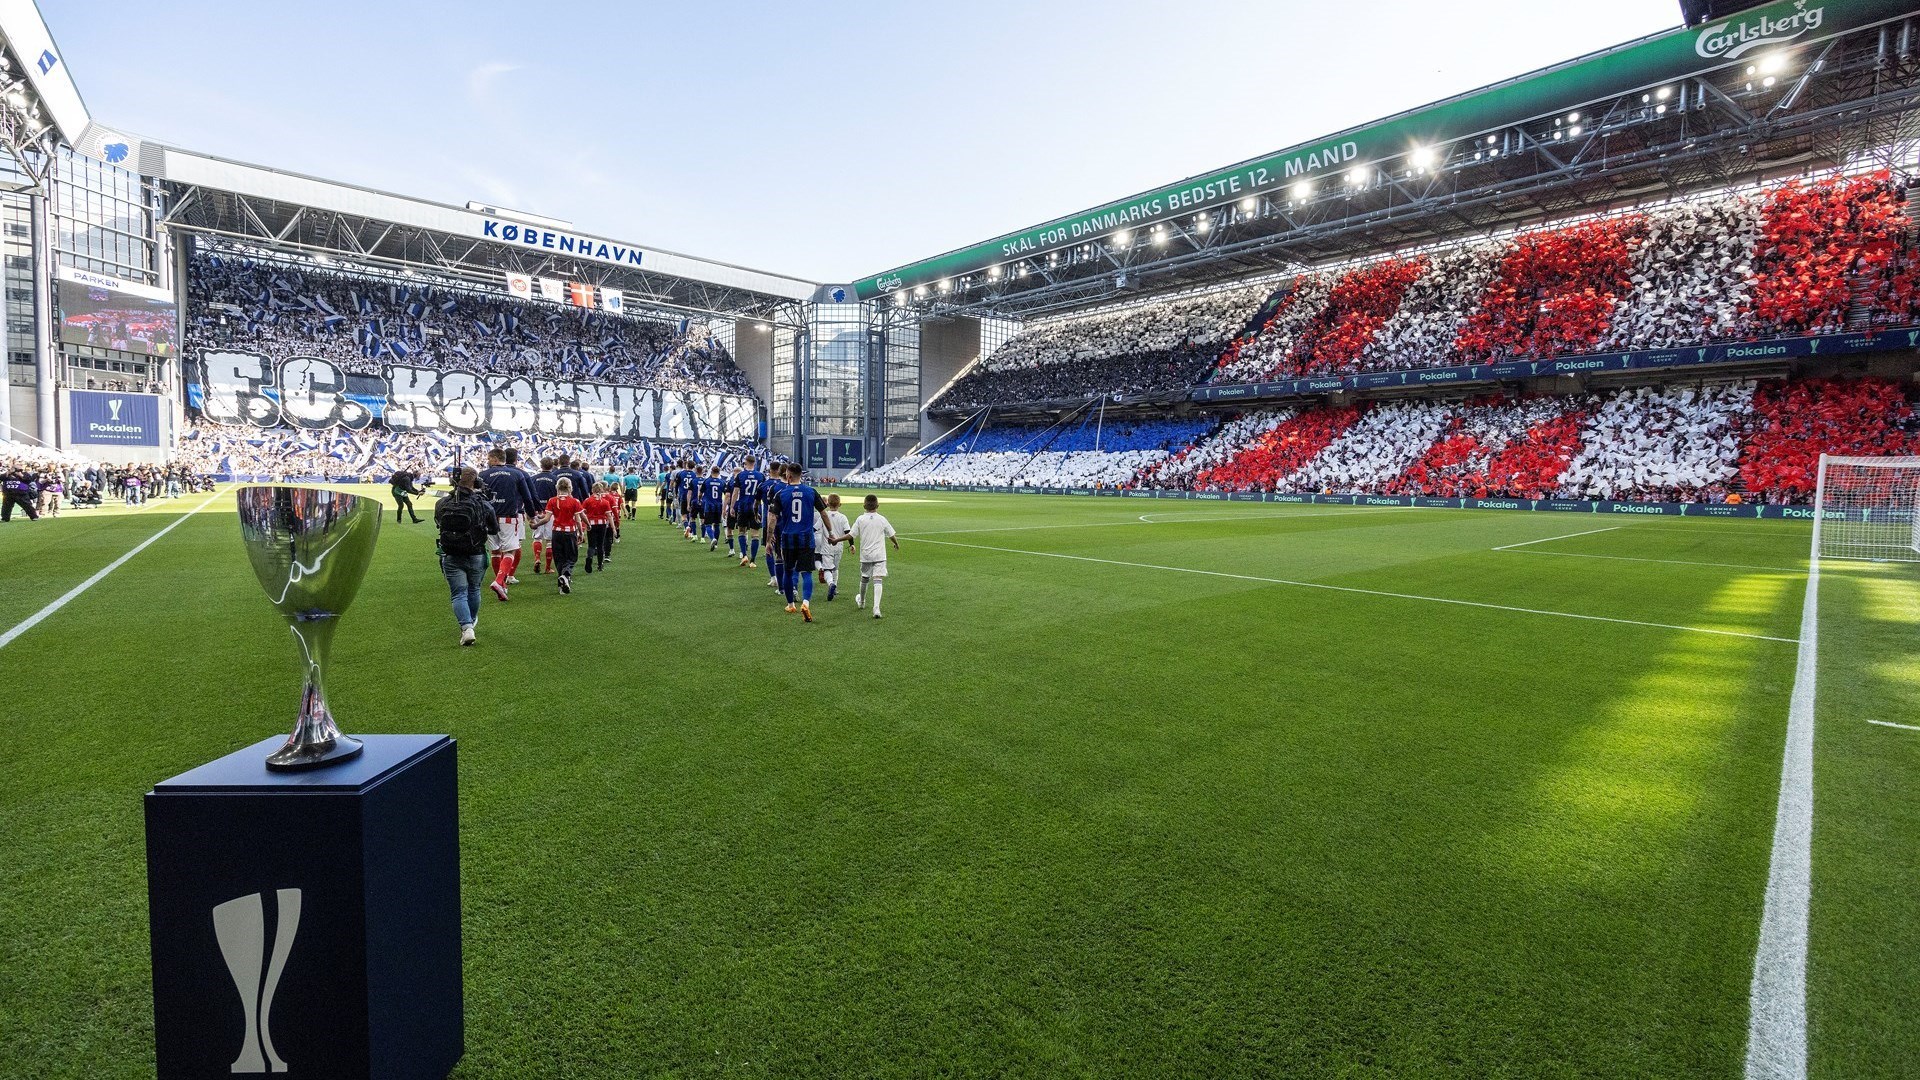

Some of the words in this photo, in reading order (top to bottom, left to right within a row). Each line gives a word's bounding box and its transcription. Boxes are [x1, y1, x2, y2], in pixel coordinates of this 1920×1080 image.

[1695, 5, 1824, 59] Carlsberg
[1002, 237, 1036, 257] SKÅL
[1039, 227, 1068, 247] FOR
[1071, 199, 1162, 238] DANMARKS
[1168, 175, 1241, 211] BEDSTE
[1248, 168, 1275, 188] 12.
[1285, 141, 1358, 178] MAND
[483, 220, 643, 266] KØBENHAVN
[73, 272, 119, 288] PARKEN
[876, 275, 902, 293] Carlsberg
[1727, 345, 1786, 357] Pokalen
[1556, 360, 1604, 370] Pokalen
[1419, 371, 1457, 380] Pokalen
[1309, 381, 1342, 389] Pokalen
[1218, 388, 1245, 396] Pokalen
[90, 422, 142, 433] Pokalen
[711, 485, 719, 499] 6
[744, 479, 758, 495] 27
[1366, 497, 1400, 505] Pokalen
[1477, 500, 1518, 509] Pokalen
[791, 498, 803, 523] 9
[1613, 504, 1663, 514] Pokalen
